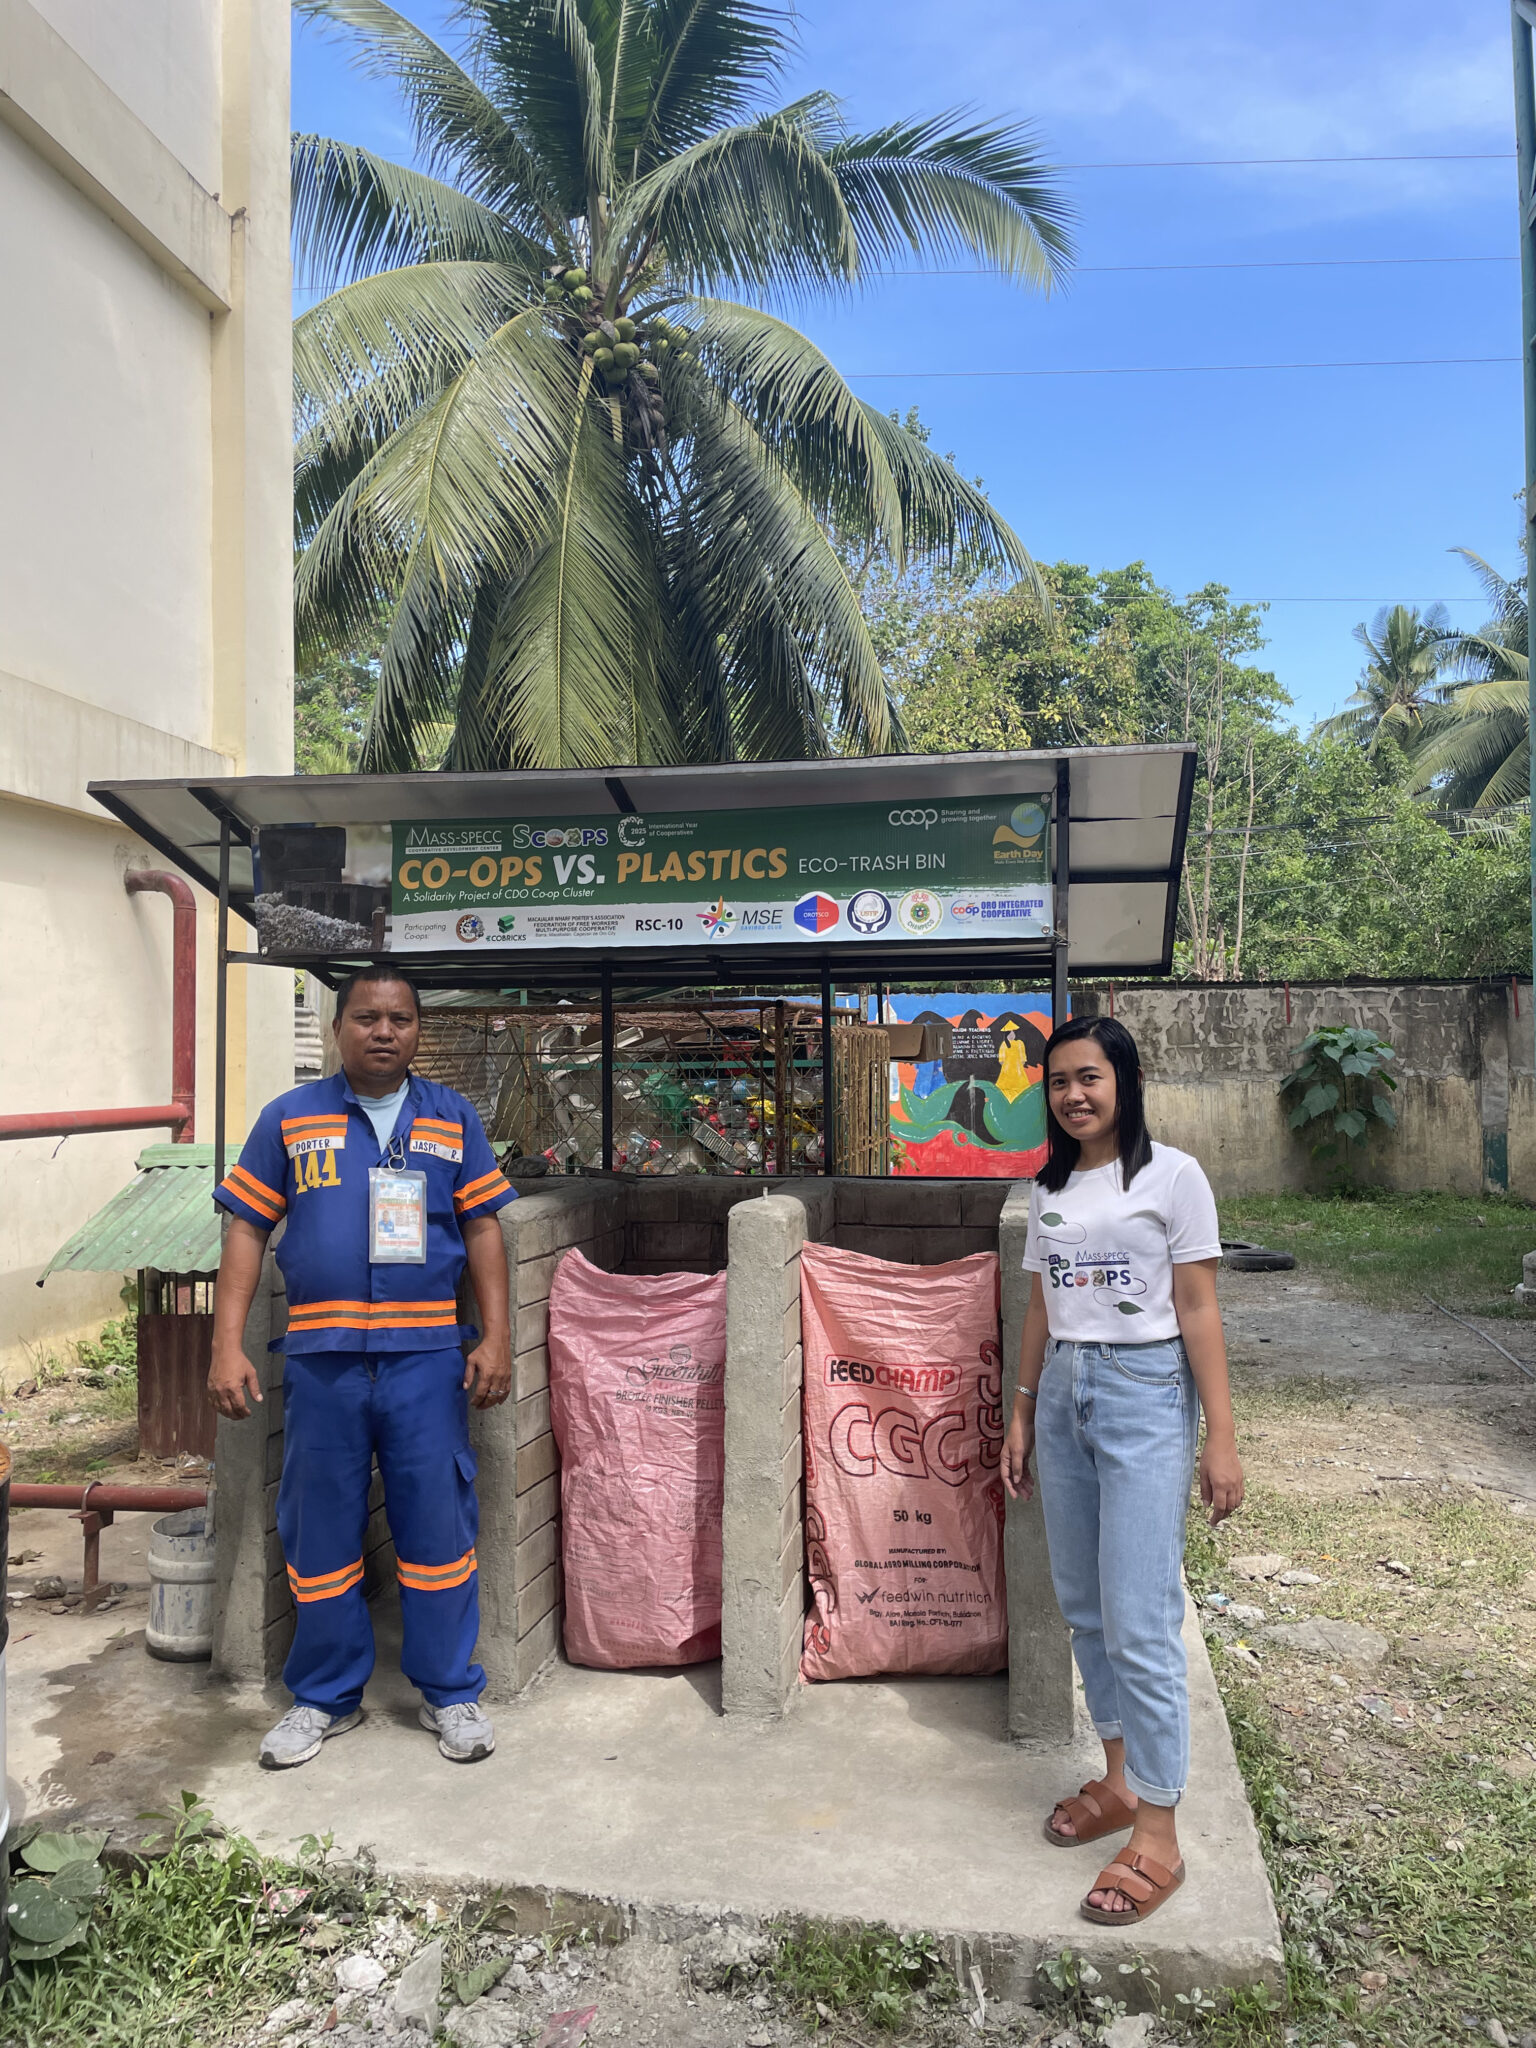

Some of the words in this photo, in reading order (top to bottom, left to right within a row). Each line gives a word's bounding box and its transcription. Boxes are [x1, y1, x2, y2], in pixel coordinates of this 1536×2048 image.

[888, 808, 938, 830] coop
[941, 809, 967, 817] Sharing
[968, 808, 981, 816] and
[941, 815, 968, 824] growing
[969, 814, 997, 823] together
[656, 830, 694, 838] Cooperatives
[993, 849, 1021, 859] Earth
[1023, 849, 1044, 859] Day
[398, 855, 543, 890] CO-OPS
[552, 853, 606, 886] VS.
[616, 847, 788, 884] PLASTICS
[799, 855, 909, 874] ECO-TRASH
[915, 853, 946, 870] BIN
[402, 893, 411, 902] A
[413, 891, 457, 903] Solidarity
[458, 890, 490, 903] Project
[492, 889, 501, 899] of
[505, 889, 529, 900] CDO
[531, 888, 560, 901] Co-op
[562, 887, 595, 898] Cluster
[981, 901, 997, 910] ORO
[998, 899, 1044, 909] INTEGRATED
[741, 909, 784, 926] MSE
[981, 909, 1032, 918] COOPERATIVE
[404, 923, 447, 932] Participating
[635, 918, 684, 932] RSC-10
[485, 934, 527, 942] ECOBRICKS
[295, 1138, 331, 1154] PORTER
[412, 1141, 437, 1153] JASPE
[294, 1150, 342, 1195] 141
[653, 1393, 694, 1409] FINISHER
[829, 1401, 970, 1487] CGC
[893, 1510, 909, 1522] 50
[915, 1509, 932, 1525] kg
[854, 1560, 883, 1569] GLOBAL
[902, 1560, 932, 1569] MILLING
[933, 1560, 982, 1573] CORPORATION
[881, 1588, 936, 1603] feedwin
[937, 1589, 992, 1605] nutrition
